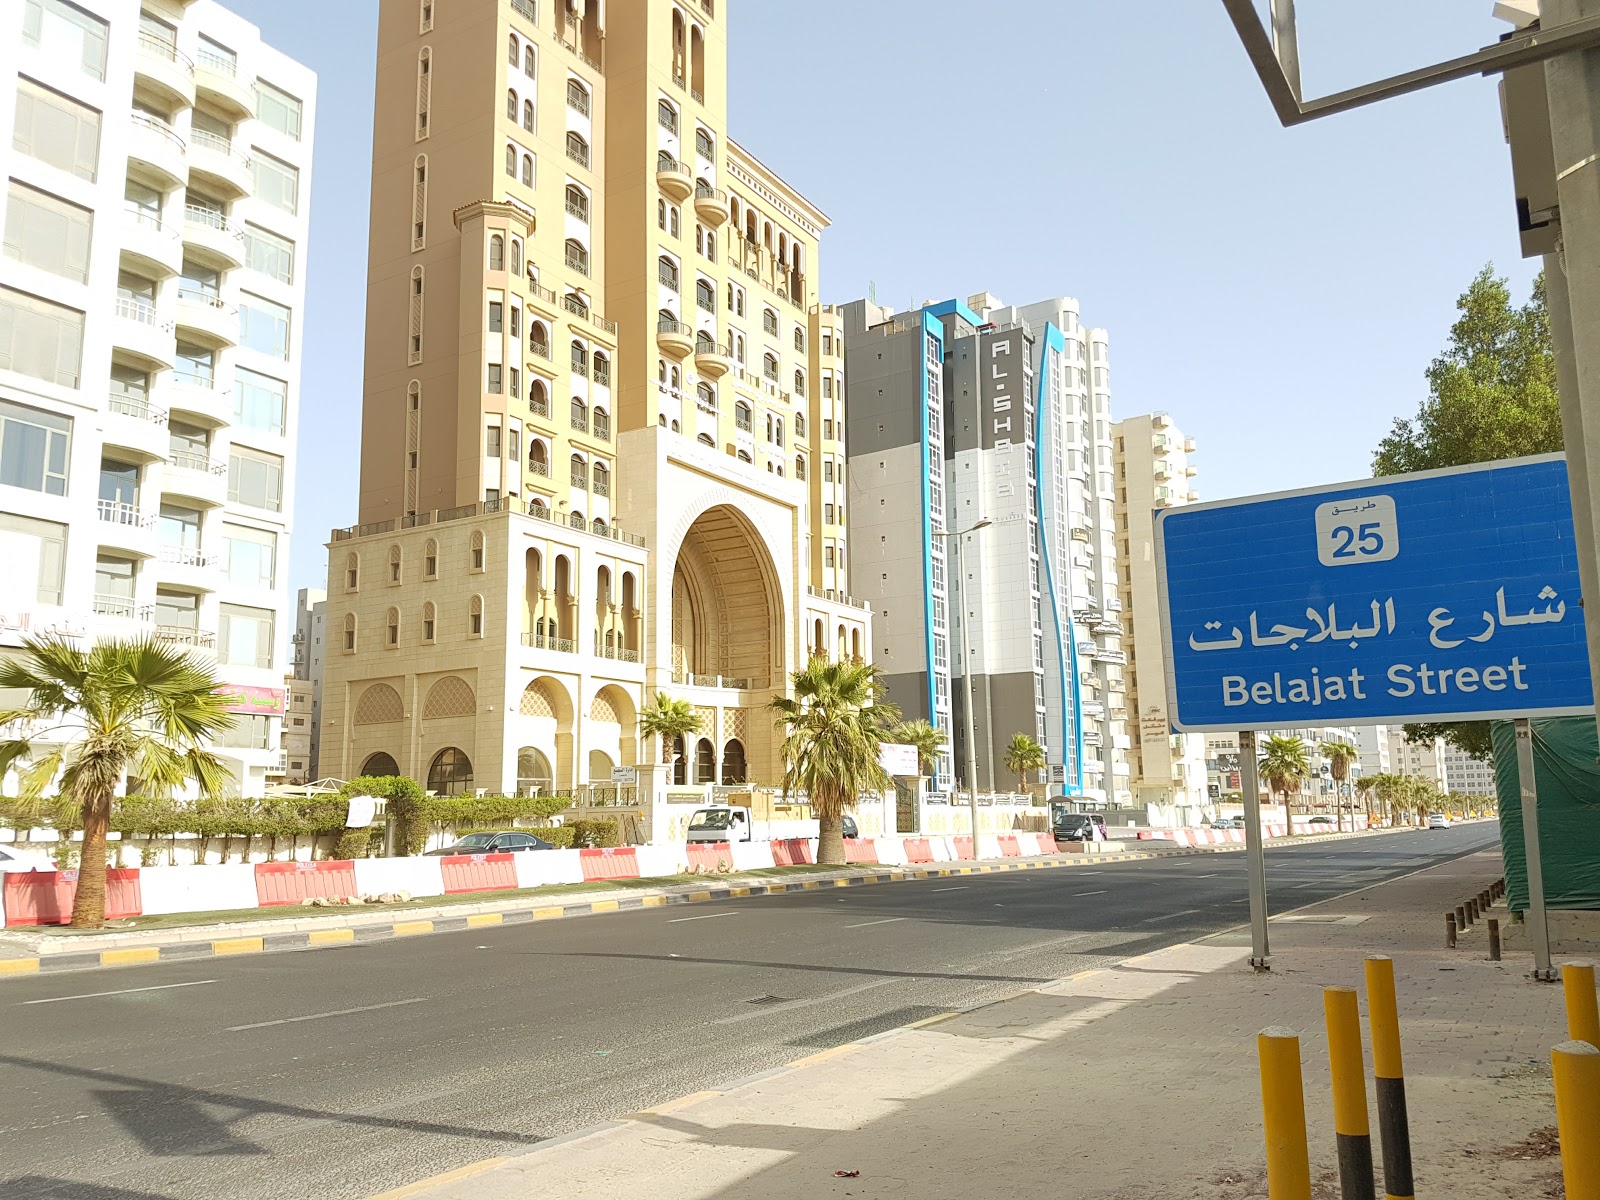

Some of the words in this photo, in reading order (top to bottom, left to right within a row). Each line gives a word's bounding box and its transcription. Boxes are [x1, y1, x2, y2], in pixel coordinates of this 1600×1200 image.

[1331, 500, 1377, 516] طريق
[1331, 522, 1384, 558] 25
[1188, 596, 1396, 651] البلاجات
[1427, 585, 1566, 649] شارع
[1222, 666, 1366, 707] Belajat
[1387, 656, 1529, 698] Street
